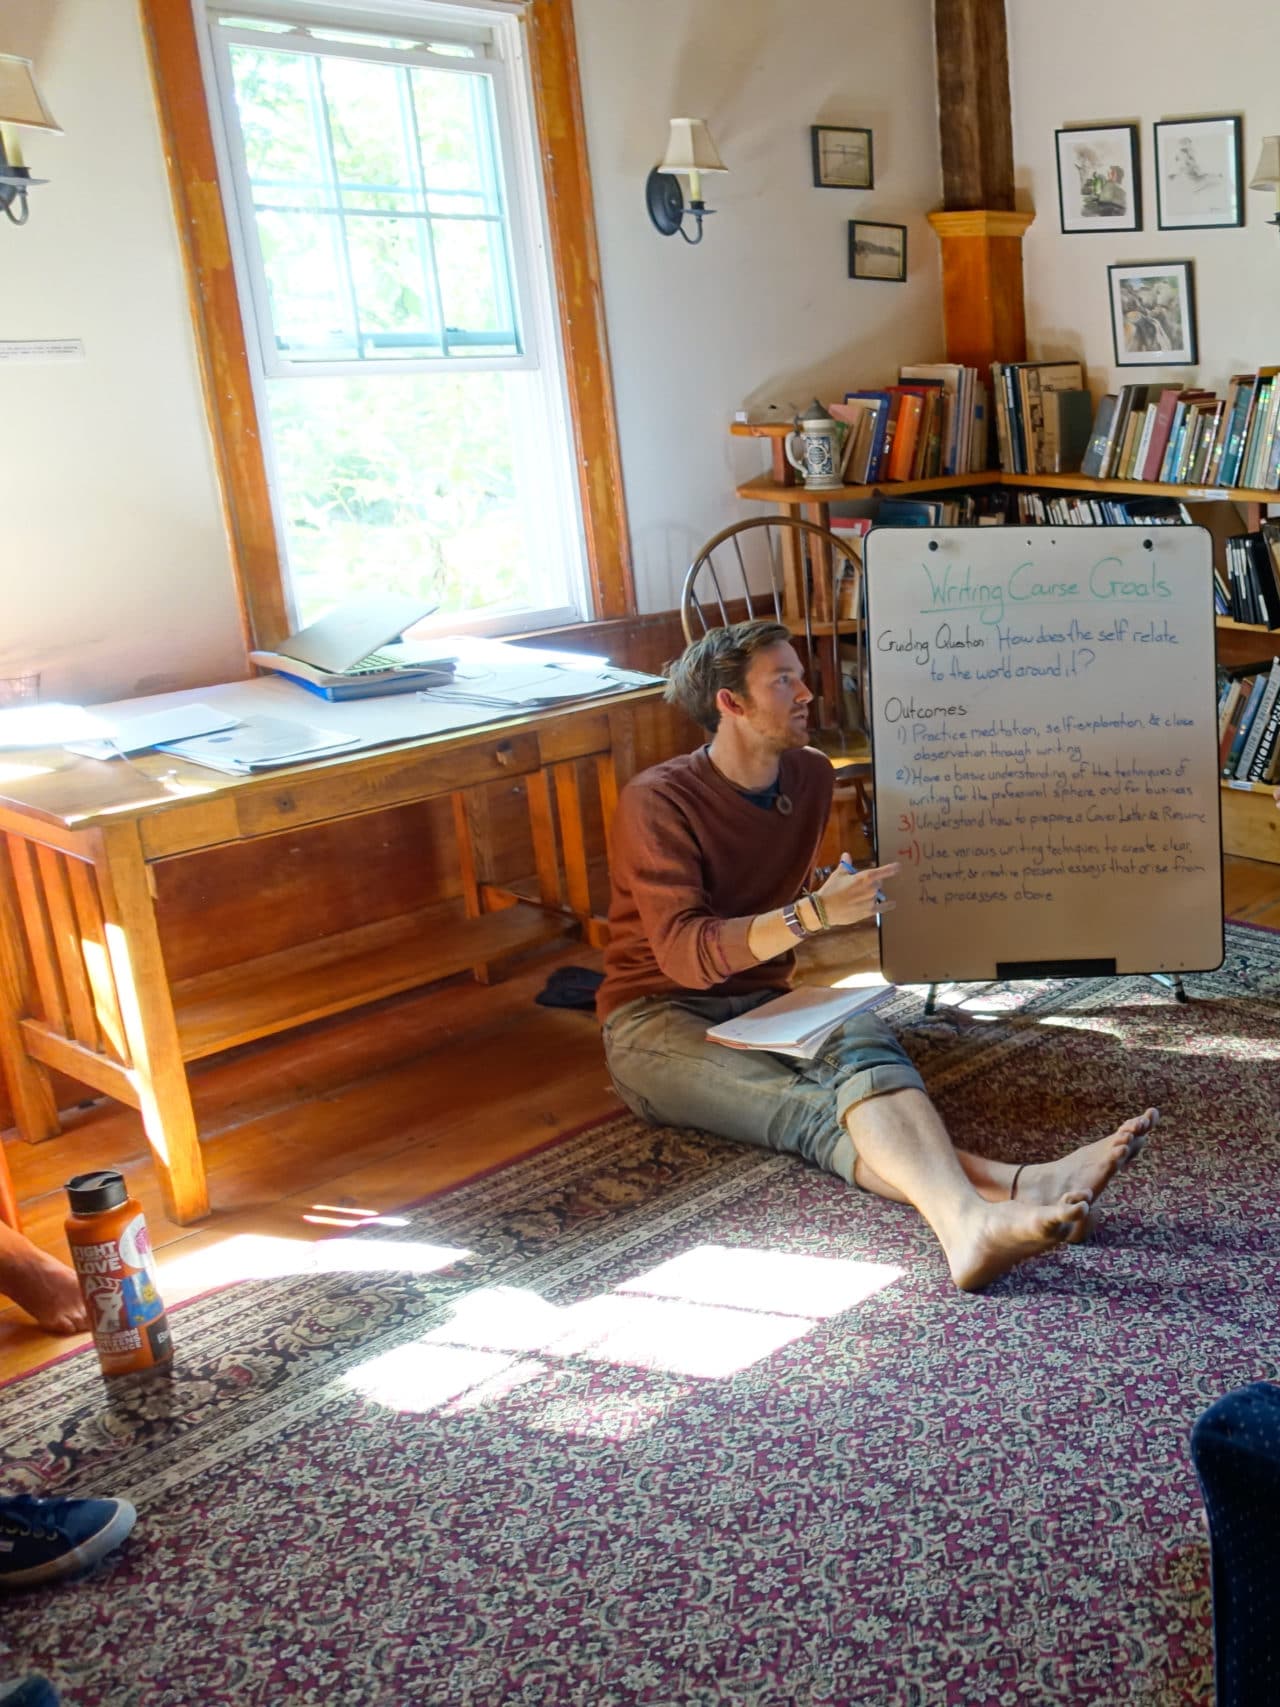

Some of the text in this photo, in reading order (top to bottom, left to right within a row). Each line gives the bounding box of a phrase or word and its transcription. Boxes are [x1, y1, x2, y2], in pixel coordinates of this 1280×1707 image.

[922, 557, 1172, 625] Writing Course Goals
[877, 628, 930, 665] Guiding
[995, 624, 1035, 651] How
[1037, 624, 1068, 644] does
[1067, 618, 1093, 643] the
[1098, 618, 1129, 643] self
[1132, 619, 1180, 644] relate
[929, 649, 1096, 682] to the world around it?
[884, 696, 968, 723] Outcomes
[912, 721, 968, 743] Practice
[1164, 711, 1195, 727] close
[913, 737, 1083, 764] observation through writing
[911, 766, 940, 785] Have
[953, 762, 985, 782] basic
[988, 759, 1068, 787] understanding
[1071, 761, 1089, 778] of
[1092, 761, 1110, 777] the
[1115, 754, 1172, 779] techniques
[1174, 757, 1191, 777] of
[908, 783, 951, 815] writing
[953, 784, 968, 801] for
[971, 784, 988, 801] the
[1099, 780, 1121, 796] and
[1124, 779, 1141, 794] for
[1144, 778, 1194, 797] business
[897, 811, 915, 835] 3)
[915, 808, 985, 831] Understand
[988, 808, 1012, 827] how
[1014, 806, 1026, 824] to
[1086, 804, 1117, 823] Cover
[1118, 802, 1148, 824] Letter
[897, 840, 921, 866] 4)
[921, 840, 949, 859] Use
[954, 847, 997, 857] various
[998, 834, 1045, 865] writing
[1103, 833, 1119, 852] to
[1067, 862, 1107, 879] essays
[1109, 856, 1136, 873] that
[1173, 855, 1206, 873] from
[918, 885, 939, 904] the
[1012, 882, 1053, 901] above
[73, 1241, 118, 1259] FIGHT
[77, 1257, 122, 1274] LOVE
